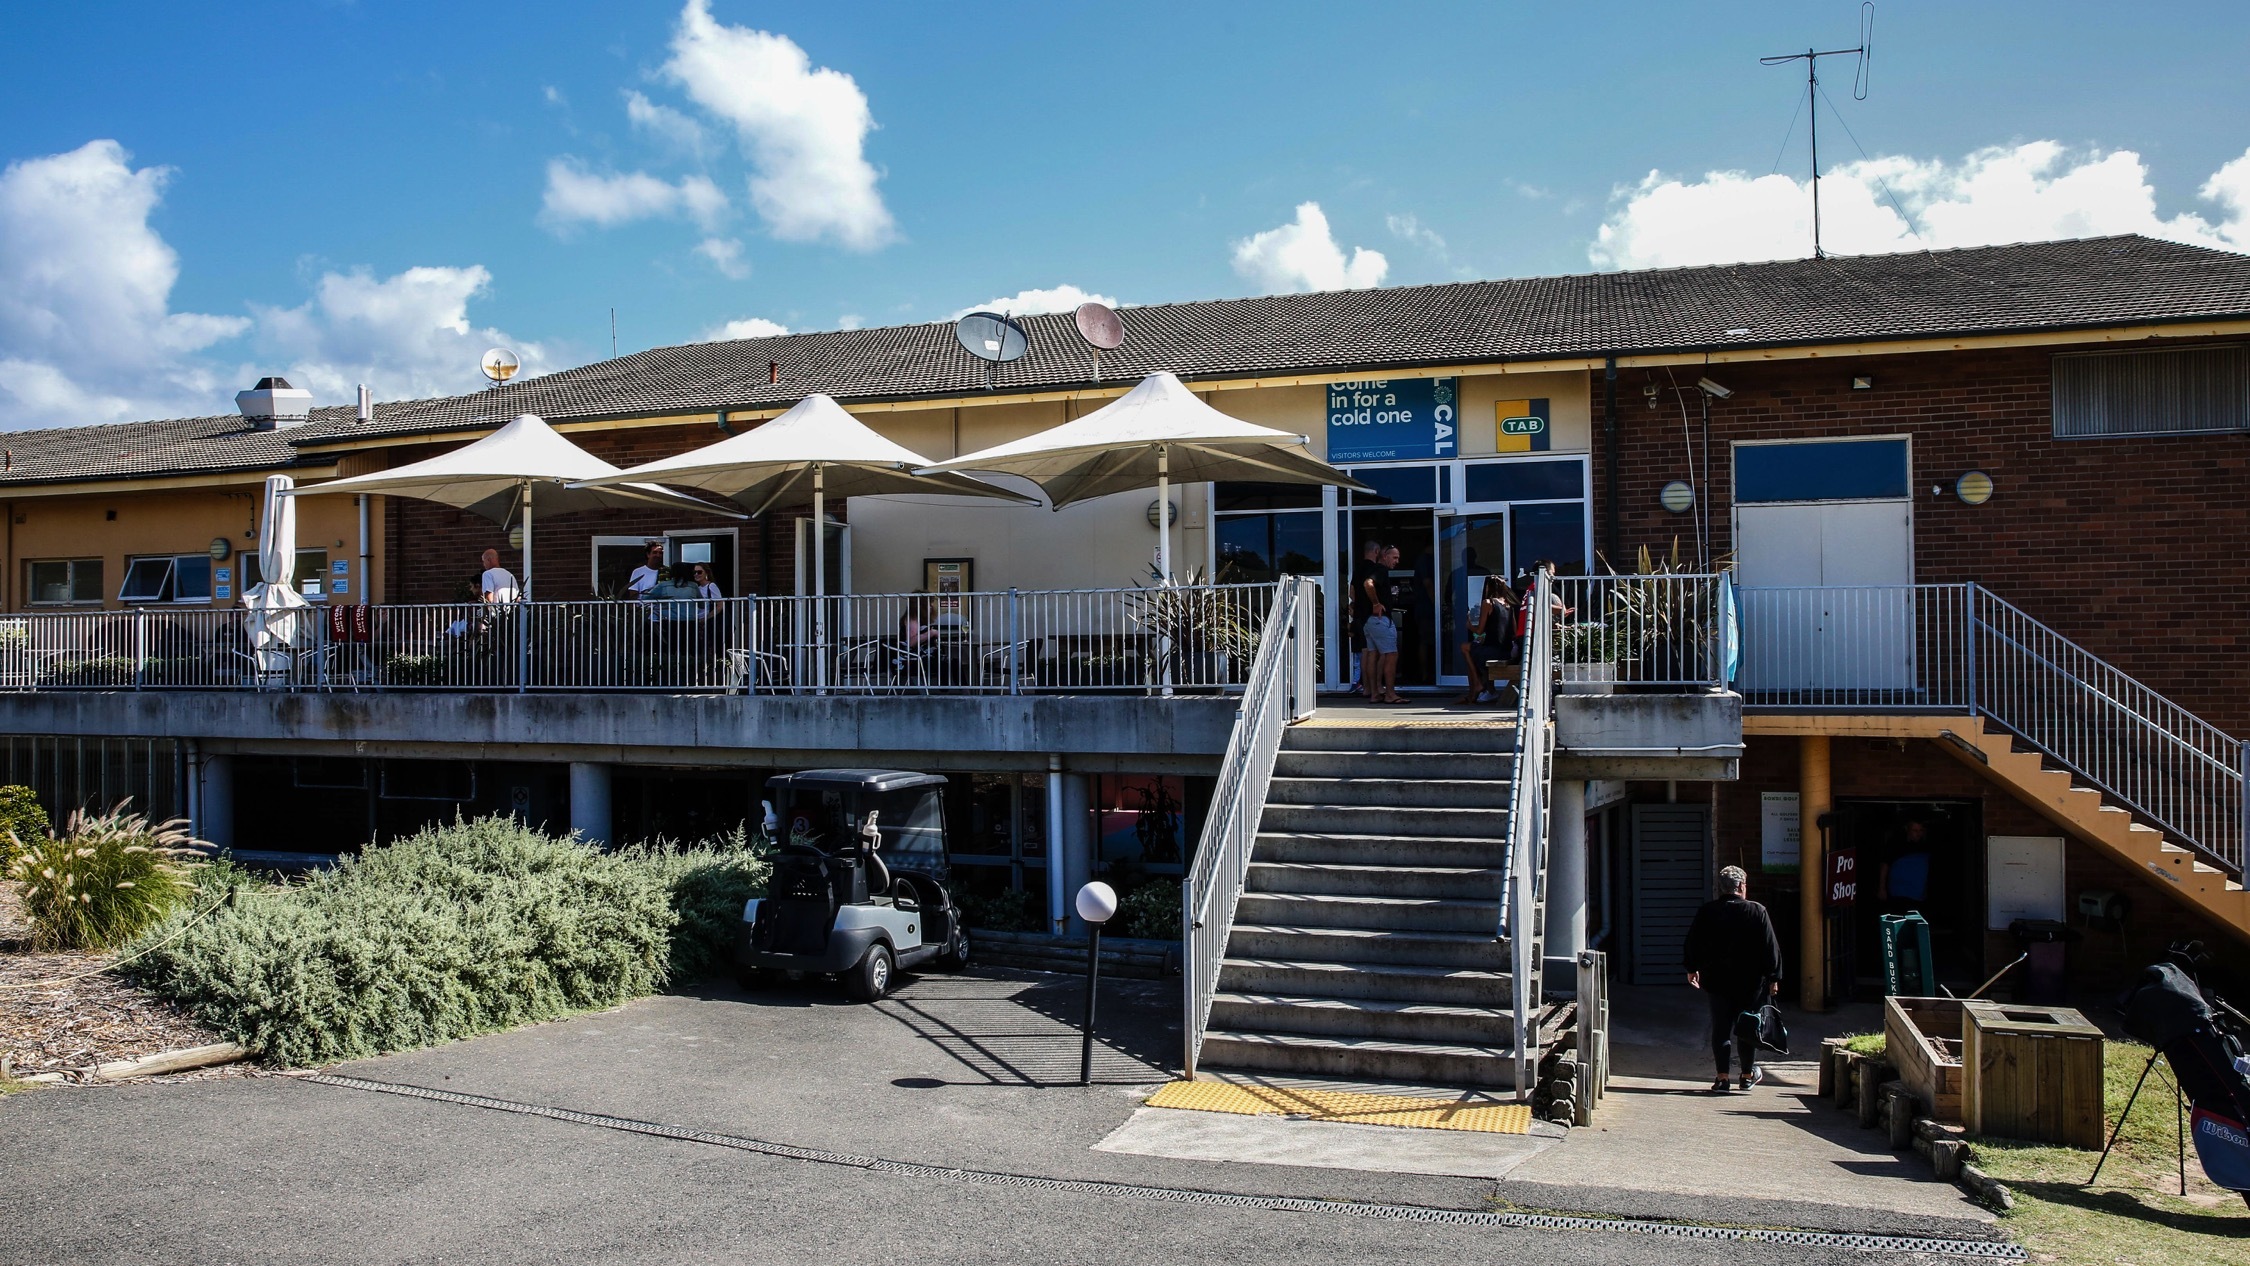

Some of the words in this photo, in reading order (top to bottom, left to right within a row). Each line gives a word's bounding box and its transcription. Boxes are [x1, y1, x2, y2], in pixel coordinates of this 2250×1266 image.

[1332, 392, 1348, 408] in
[1353, 391, 1380, 407] for
[1384, 393, 1395, 406] a
[1331, 409, 1371, 426] cold
[1376, 410, 1412, 424] one
[1508, 421, 1538, 431] TAB
[795, 818, 805, 832] 3
[1836, 855, 1854, 873] Pro
[1833, 882, 1856, 901] Shop
[1885, 928, 1893, 958] SAND
[2202, 1120, 2249, 1147] Wilson
